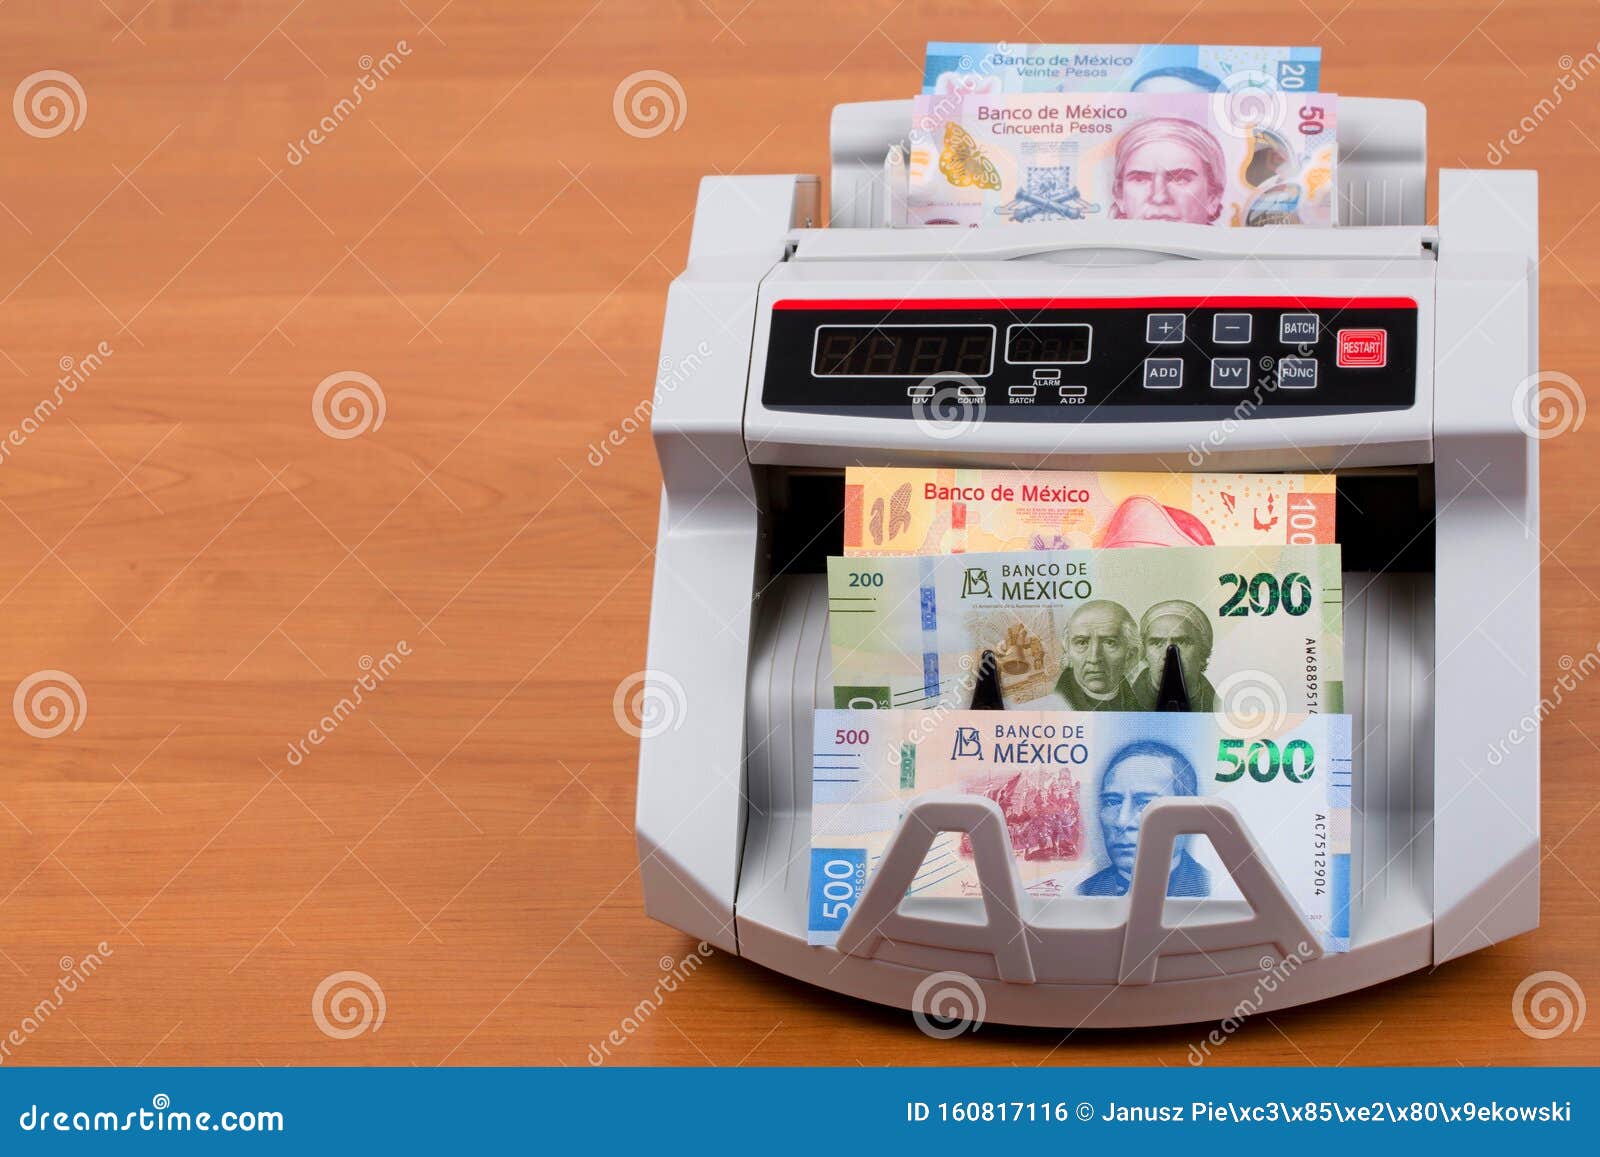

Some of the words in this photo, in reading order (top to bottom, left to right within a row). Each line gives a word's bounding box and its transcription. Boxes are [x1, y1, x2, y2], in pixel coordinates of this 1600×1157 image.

[993, 54, 1045, 65] Banco
[1050, 55, 1068, 65] de
[1074, 54, 1133, 66] México
[1017, 67, 1058, 77] Veinte
[1066, 68, 1107, 77] Pesos
[1281, 64, 1305, 89] 20
[978, 106, 1032, 120] Banco
[1038, 107, 1058, 119] de
[1066, 105, 1127, 119] México
[992, 122, 1063, 134] Cincuenta
[1070, 122, 1112, 133] Pesos
[1299, 106, 1324, 135] 50
[1284, 322, 1315, 334] BATCH
[1343, 342, 1381, 353] RESTART
[1150, 368, 1178, 378] ADD
[1219, 367, 1242, 377] UV
[1282, 368, 1314, 378] FUNC
[1033, 379, 1060, 387] ALARM
[924, 483, 984, 501] Banco
[991, 484, 1014, 501] de
[1022, 485, 1090, 503] México
[1002, 563, 1060, 577] BANCO
[1066, 562, 1087, 576] DE
[849, 572, 884, 587] 200
[1001, 578, 1092, 601] MÉXICO
[1219, 572, 1312, 617] 200
[835, 729, 869, 745] 500
[995, 725, 1055, 739] BANCO
[1062, 725, 1084, 738] DE
[994, 740, 1088, 764] MÉXICO
[1215, 738, 1315, 783] 500
[1314, 813, 1325, 896] AC7512904
[823, 860, 854, 919] 500
